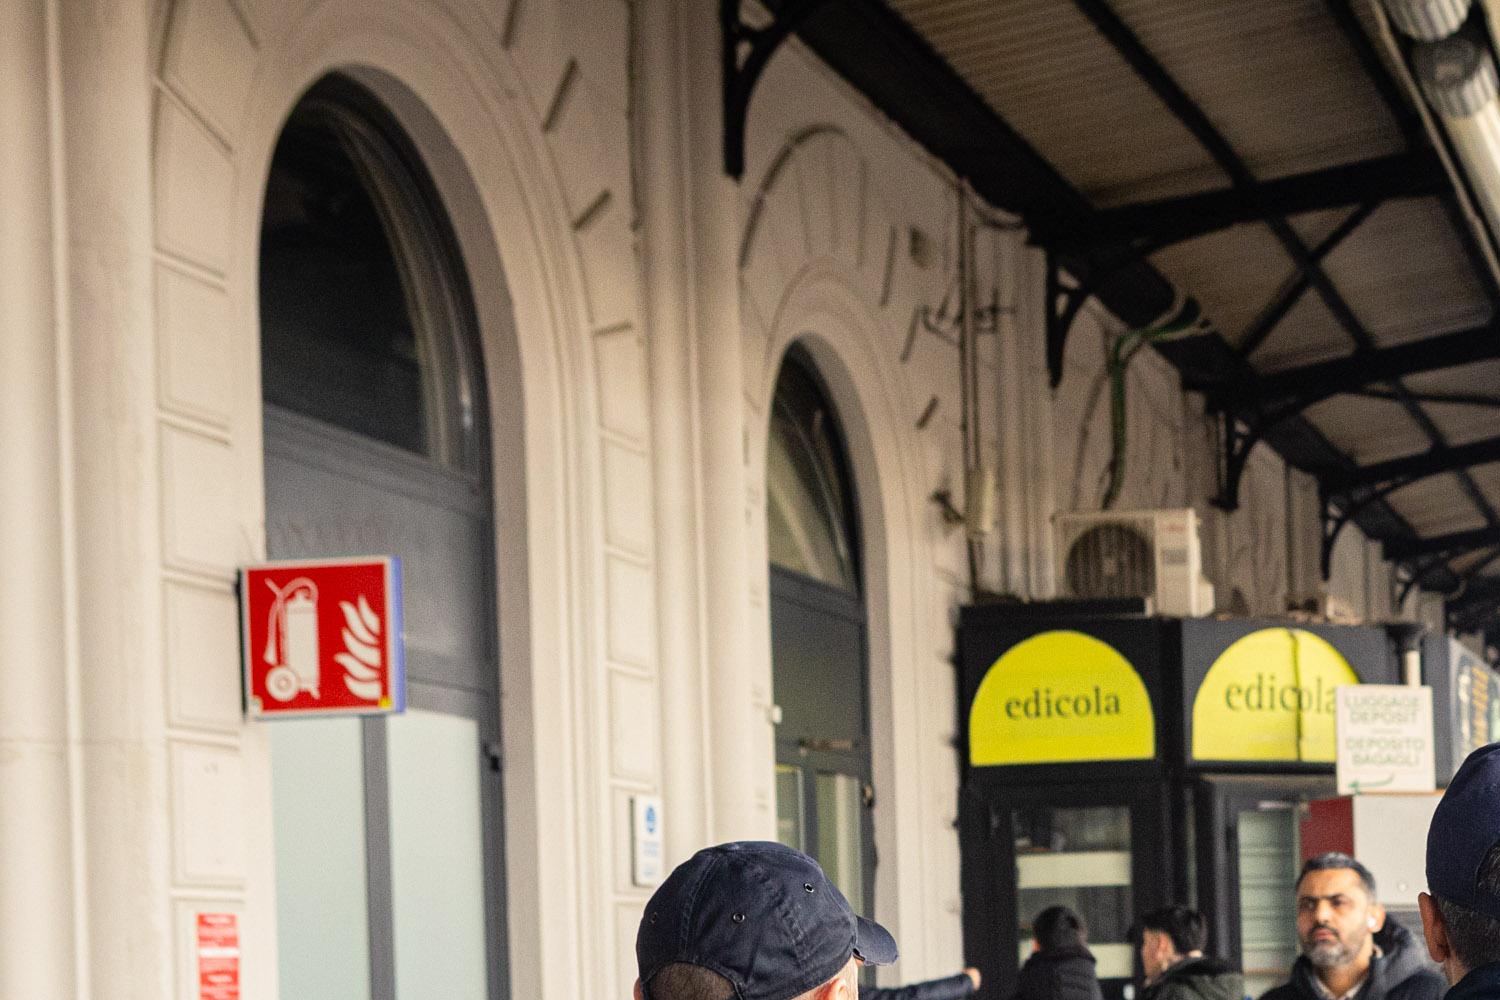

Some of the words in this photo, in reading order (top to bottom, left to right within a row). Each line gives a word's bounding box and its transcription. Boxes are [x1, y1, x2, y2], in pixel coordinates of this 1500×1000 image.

[1005, 687, 1121, 719] edicola
[1344, 695, 1421, 708] LUGGAGE
[1351, 710, 1417, 724] DEPOSIT
[1346, 737, 1425, 751] DEPOSITO
[1352, 753, 1420, 768] BAGAGLI
